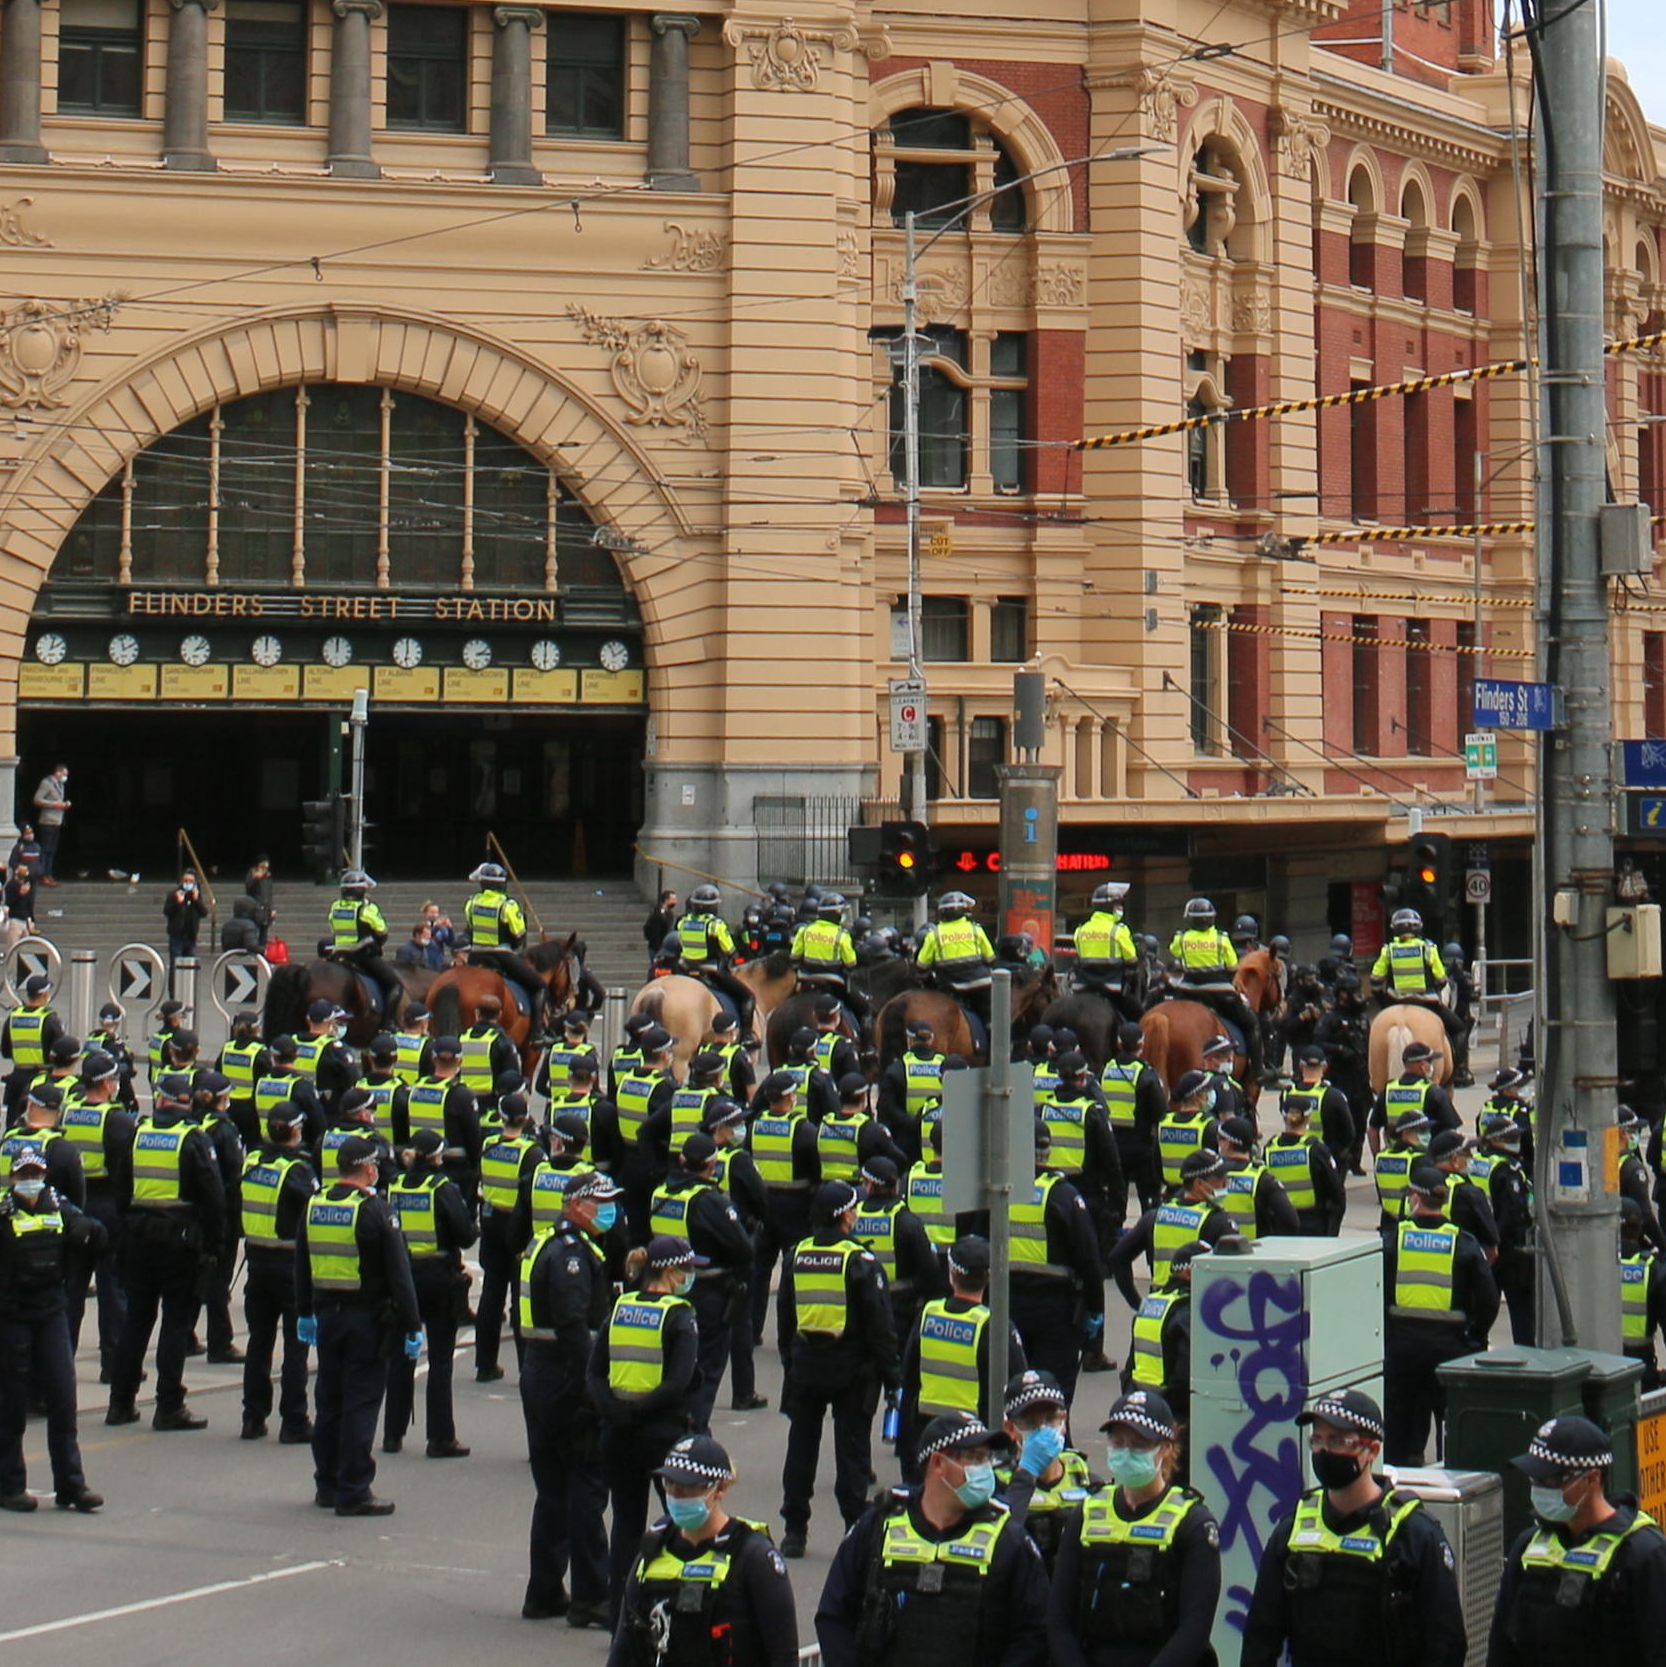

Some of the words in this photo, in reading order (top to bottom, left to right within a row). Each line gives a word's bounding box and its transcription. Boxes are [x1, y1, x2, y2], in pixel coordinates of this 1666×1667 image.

[128, 592, 264, 616] FLINDERS
[300, 595, 401, 618] STREET
[435, 597, 556, 621] STATION
[1475, 682, 1515, 712] Flinders
[1517, 684, 1528, 713] St
[1471, 880, 1487, 893] 40
[806, 931, 835, 944] Police
[942, 932, 974, 943] Police
[1185, 939, 1217, 950] Police
[1391, 1091, 1418, 1102] Police
[68, 1110, 99, 1124] Police
[757, 1121, 789, 1135] Police
[1162, 1128, 1197, 1143] Police
[141, 1134, 176, 1149] Police
[1271, 1150, 1307, 1165] Police
[538, 1174, 569, 1190] Polic
[913, 1180, 943, 1194] Polic
[312, 1206, 352, 1224] Police
[1160, 1206, 1200, 1226] Police
[854, 1219, 889, 1234] olice
[1406, 1232, 1451, 1251] Police
[796, 1255, 842, 1266] POLICE
[618, 1306, 660, 1327] Police
[924, 1316, 974, 1342] Police
[1643, 1418, 1660, 1455] USE
[1640, 1460, 1666, 1500] OTHER
